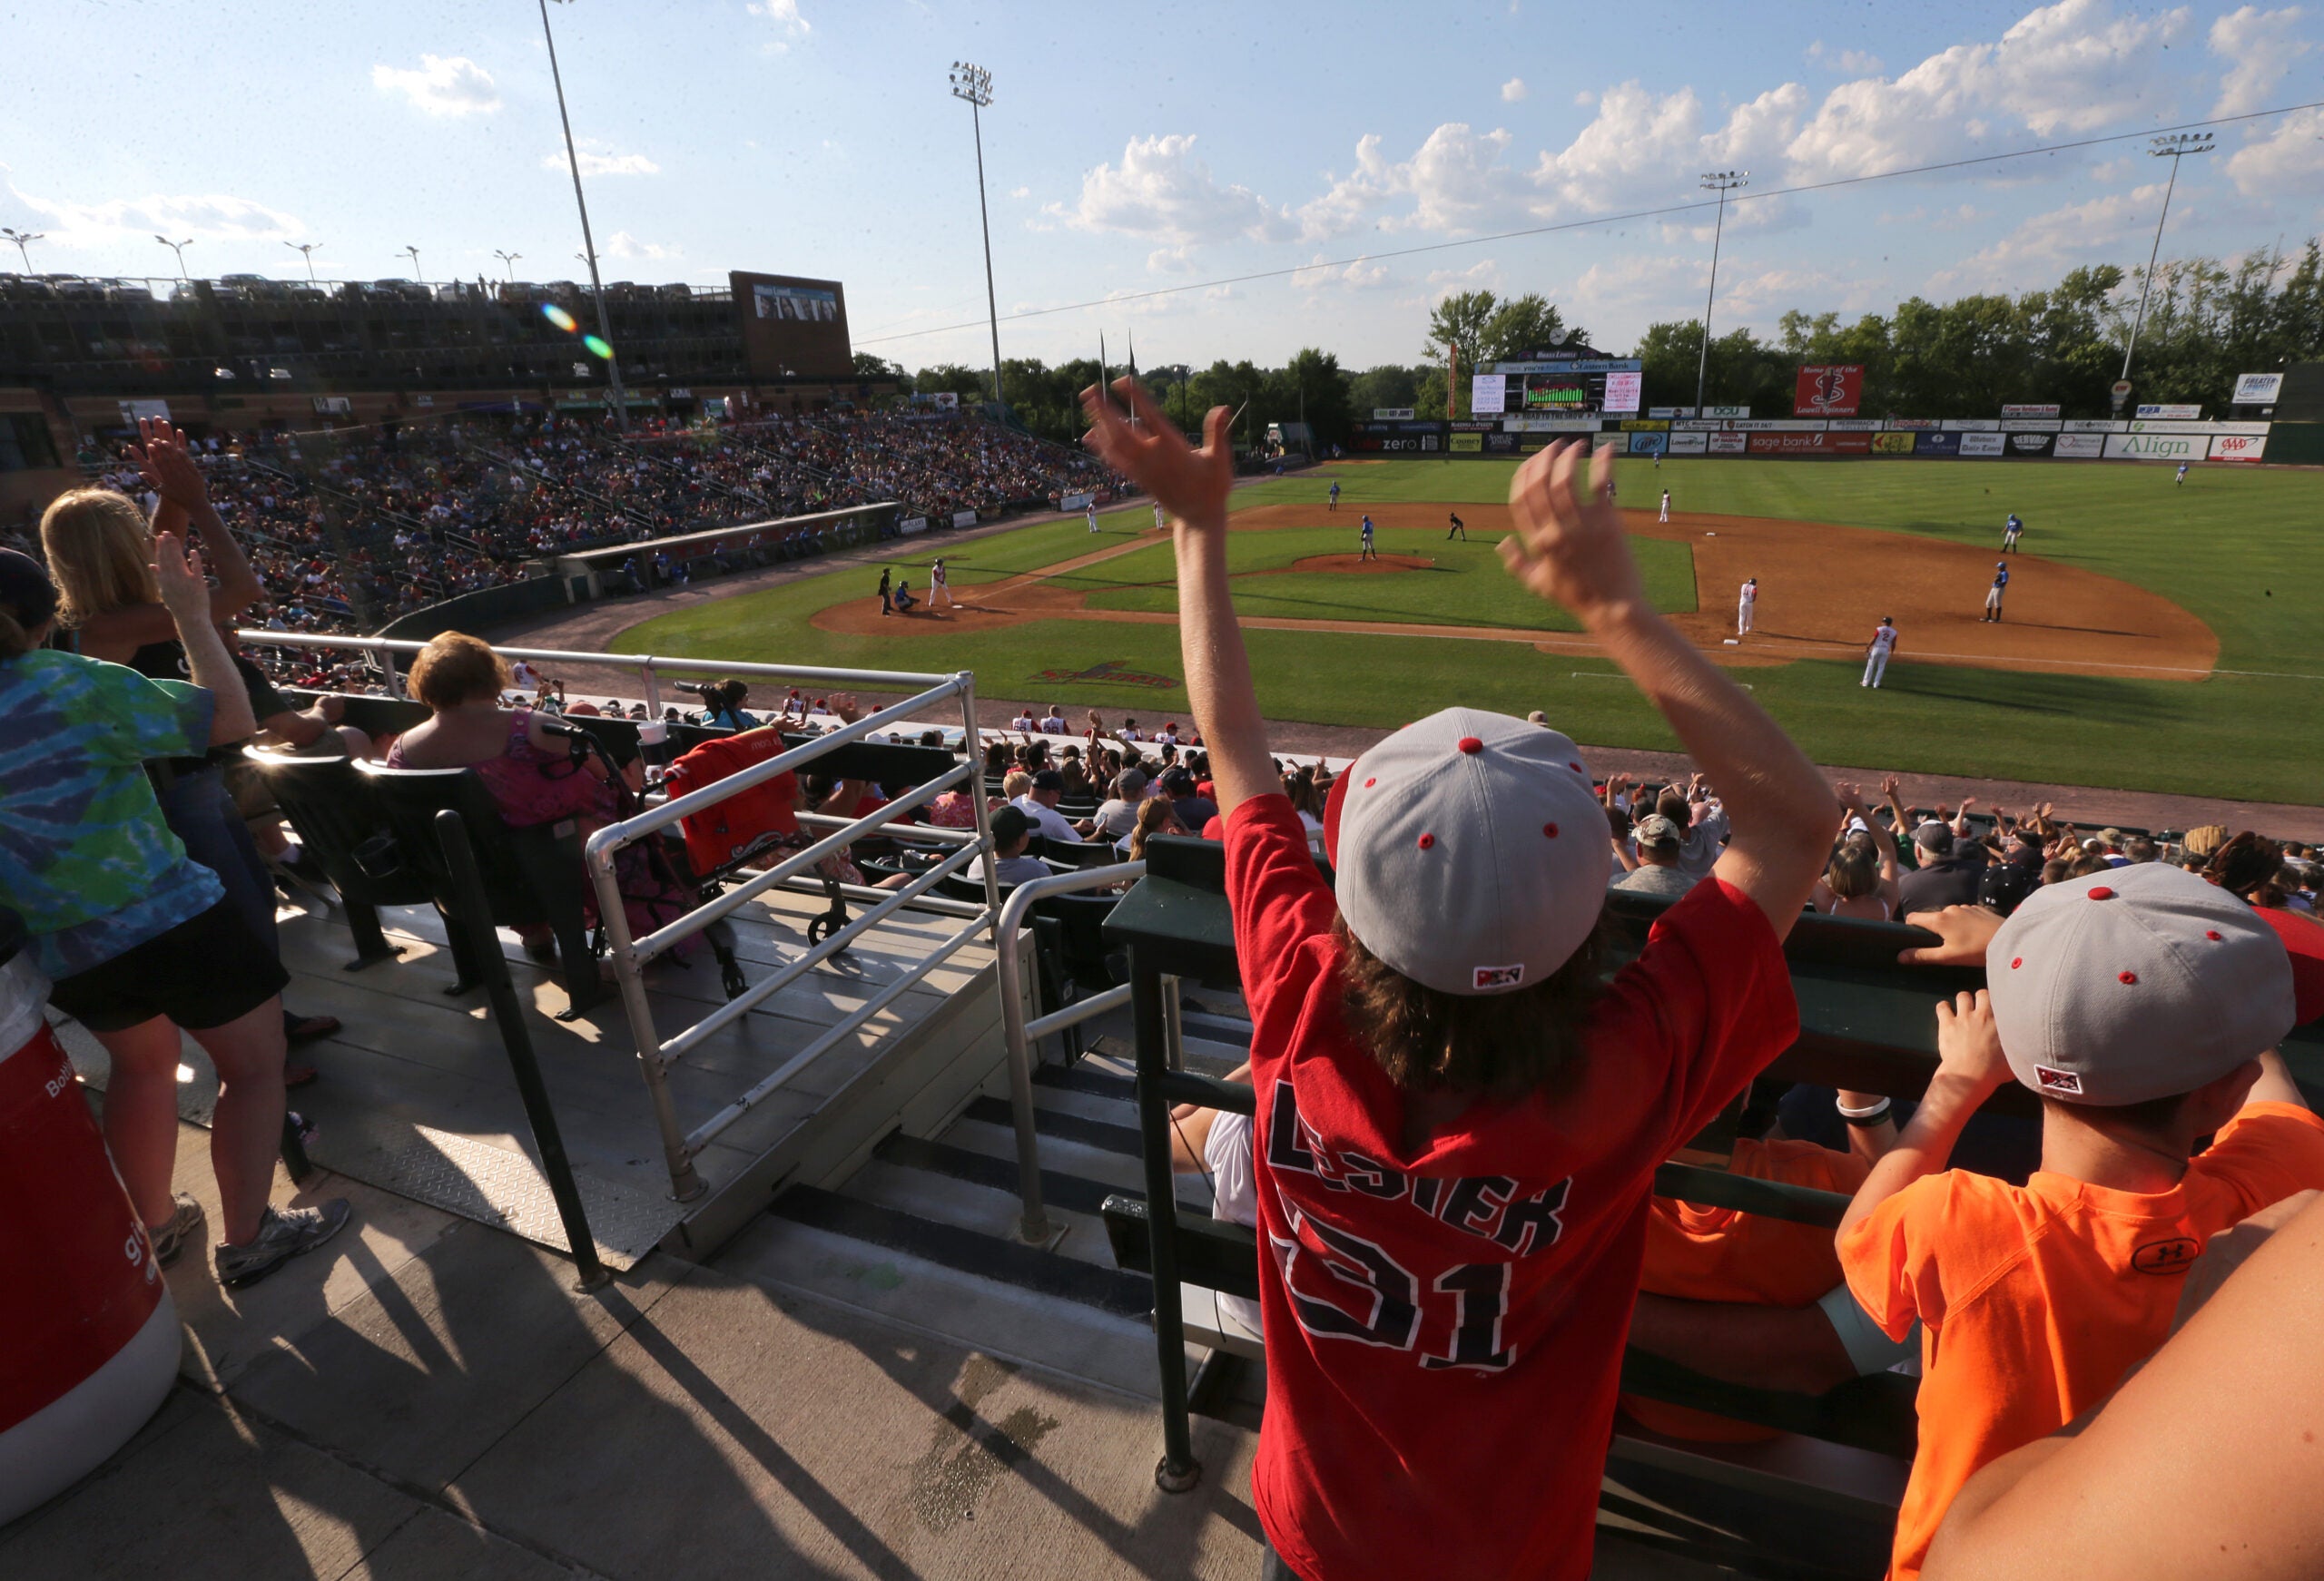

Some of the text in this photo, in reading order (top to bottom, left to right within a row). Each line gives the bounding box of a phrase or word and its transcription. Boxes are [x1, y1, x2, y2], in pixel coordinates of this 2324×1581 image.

[1580, 361, 1629, 370] Eastern Bank
[1797, 406, 1856, 414] Lowell Spinners
[1383, 439, 1416, 450] zero
[1752, 436, 1812, 450] sage bank
[2122, 437, 2190, 457] Align
[2222, 437, 2247, 450] AAA
[1882, 633, 1890, 643] 2
